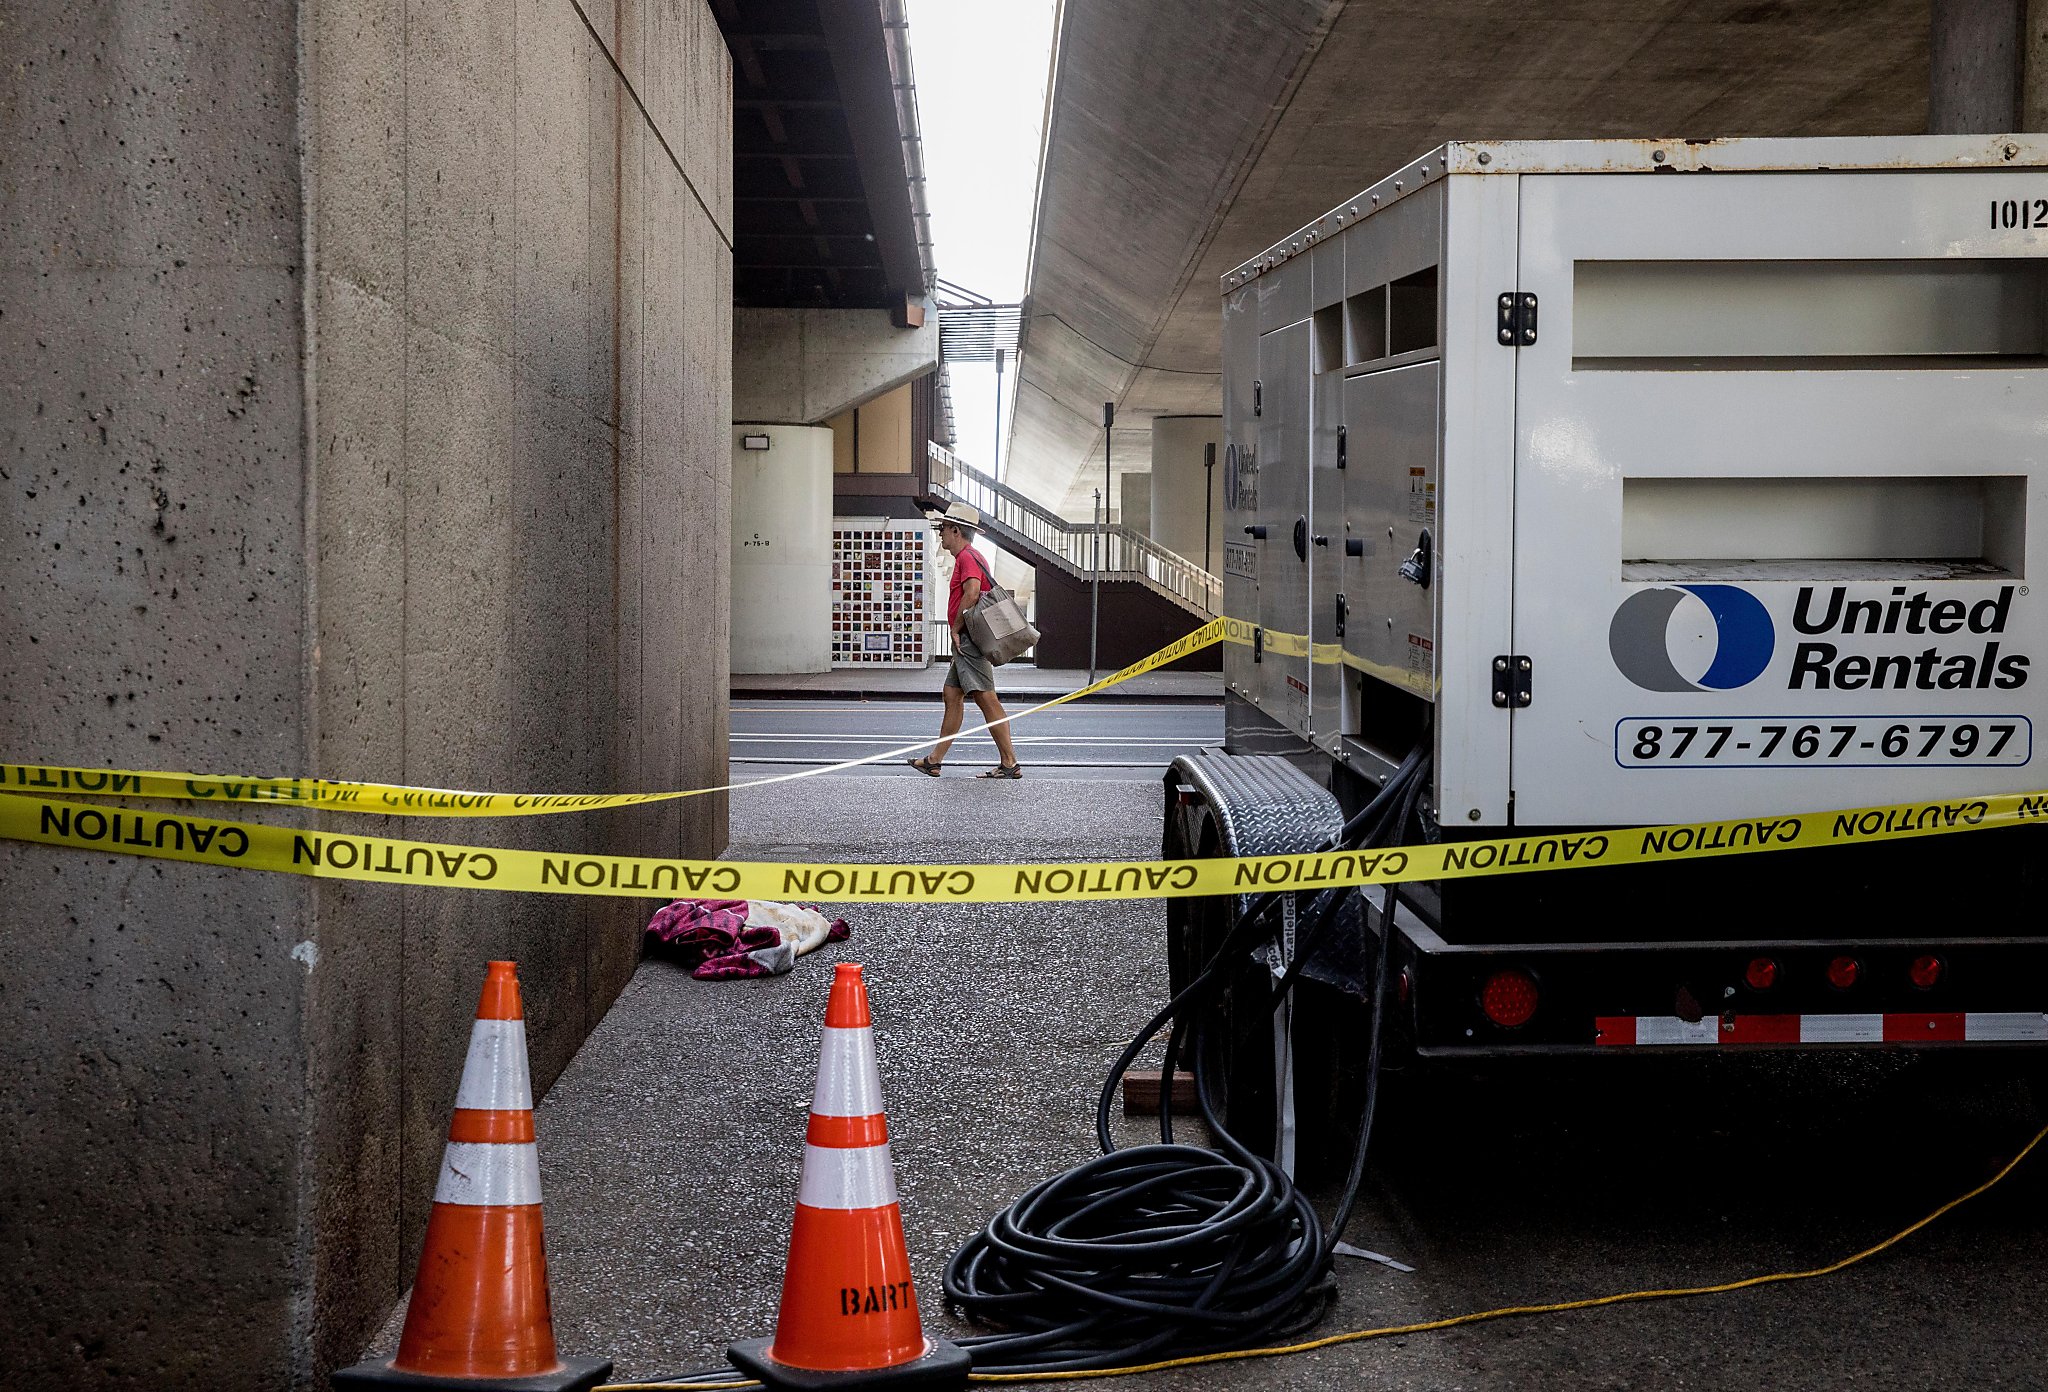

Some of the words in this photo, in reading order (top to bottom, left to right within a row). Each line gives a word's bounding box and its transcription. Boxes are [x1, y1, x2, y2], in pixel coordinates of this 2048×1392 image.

[1990, 199, 2048, 230] 1012
[1791, 586, 2016, 635] United
[1787, 641, 2031, 691] Rentals
[1631, 723, 2017, 760] 877-767-6797
[40, 804, 249, 858] CAUTION
[1640, 817, 1802, 855] CAUTION
[1832, 801, 1989, 837] CAUTION
[292, 835, 498, 881] CAUTION
[1234, 852, 1410, 886] CAUTION
[1442, 835, 1609, 871] CAUTION
[541, 858, 741, 893] CAUTION
[783, 868, 975, 895] CAUTION
[1014, 865, 1199, 894] CAUTION
[841, 1281, 909, 1316] BART
